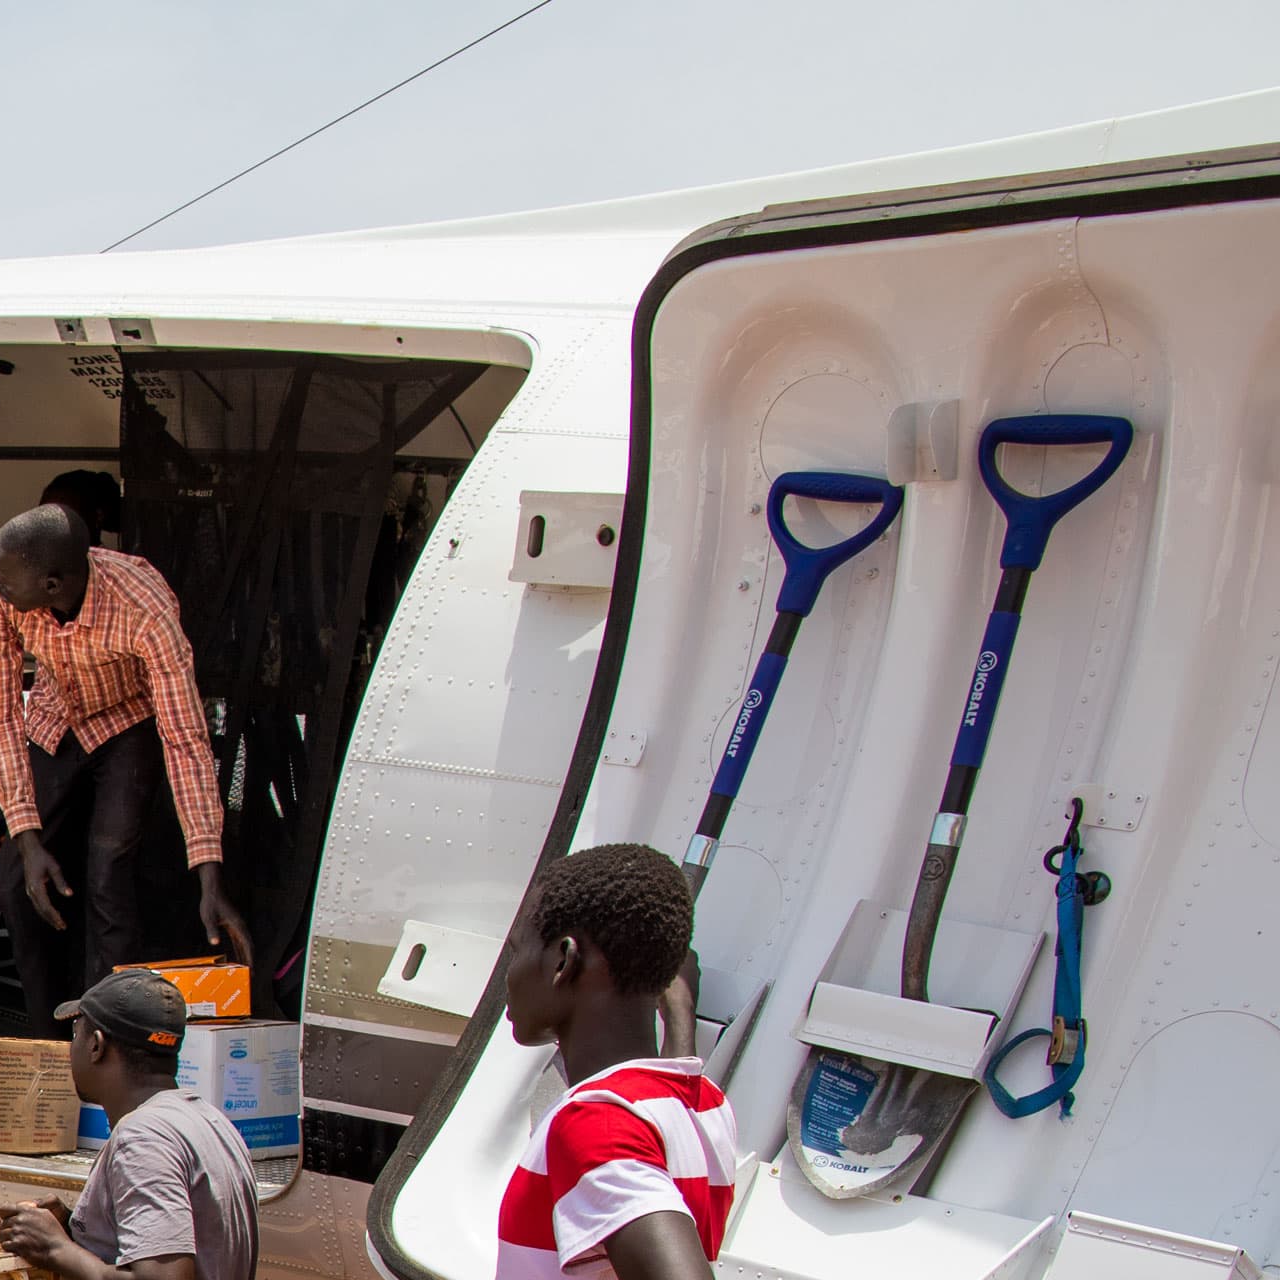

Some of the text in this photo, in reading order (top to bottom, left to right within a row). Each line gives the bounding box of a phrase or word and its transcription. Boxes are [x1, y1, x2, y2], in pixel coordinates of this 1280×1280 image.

[68, 354, 120, 366] ZONE
[70, 366, 111, 377] MAX
[964, 672, 990, 727] KOBALT
[725, 708, 753, 758] KOBALT
[147, 1032, 177, 1047] KTM
[234, 1100, 259, 1112] unicef
[828, 1160, 870, 1174] KOBALT
